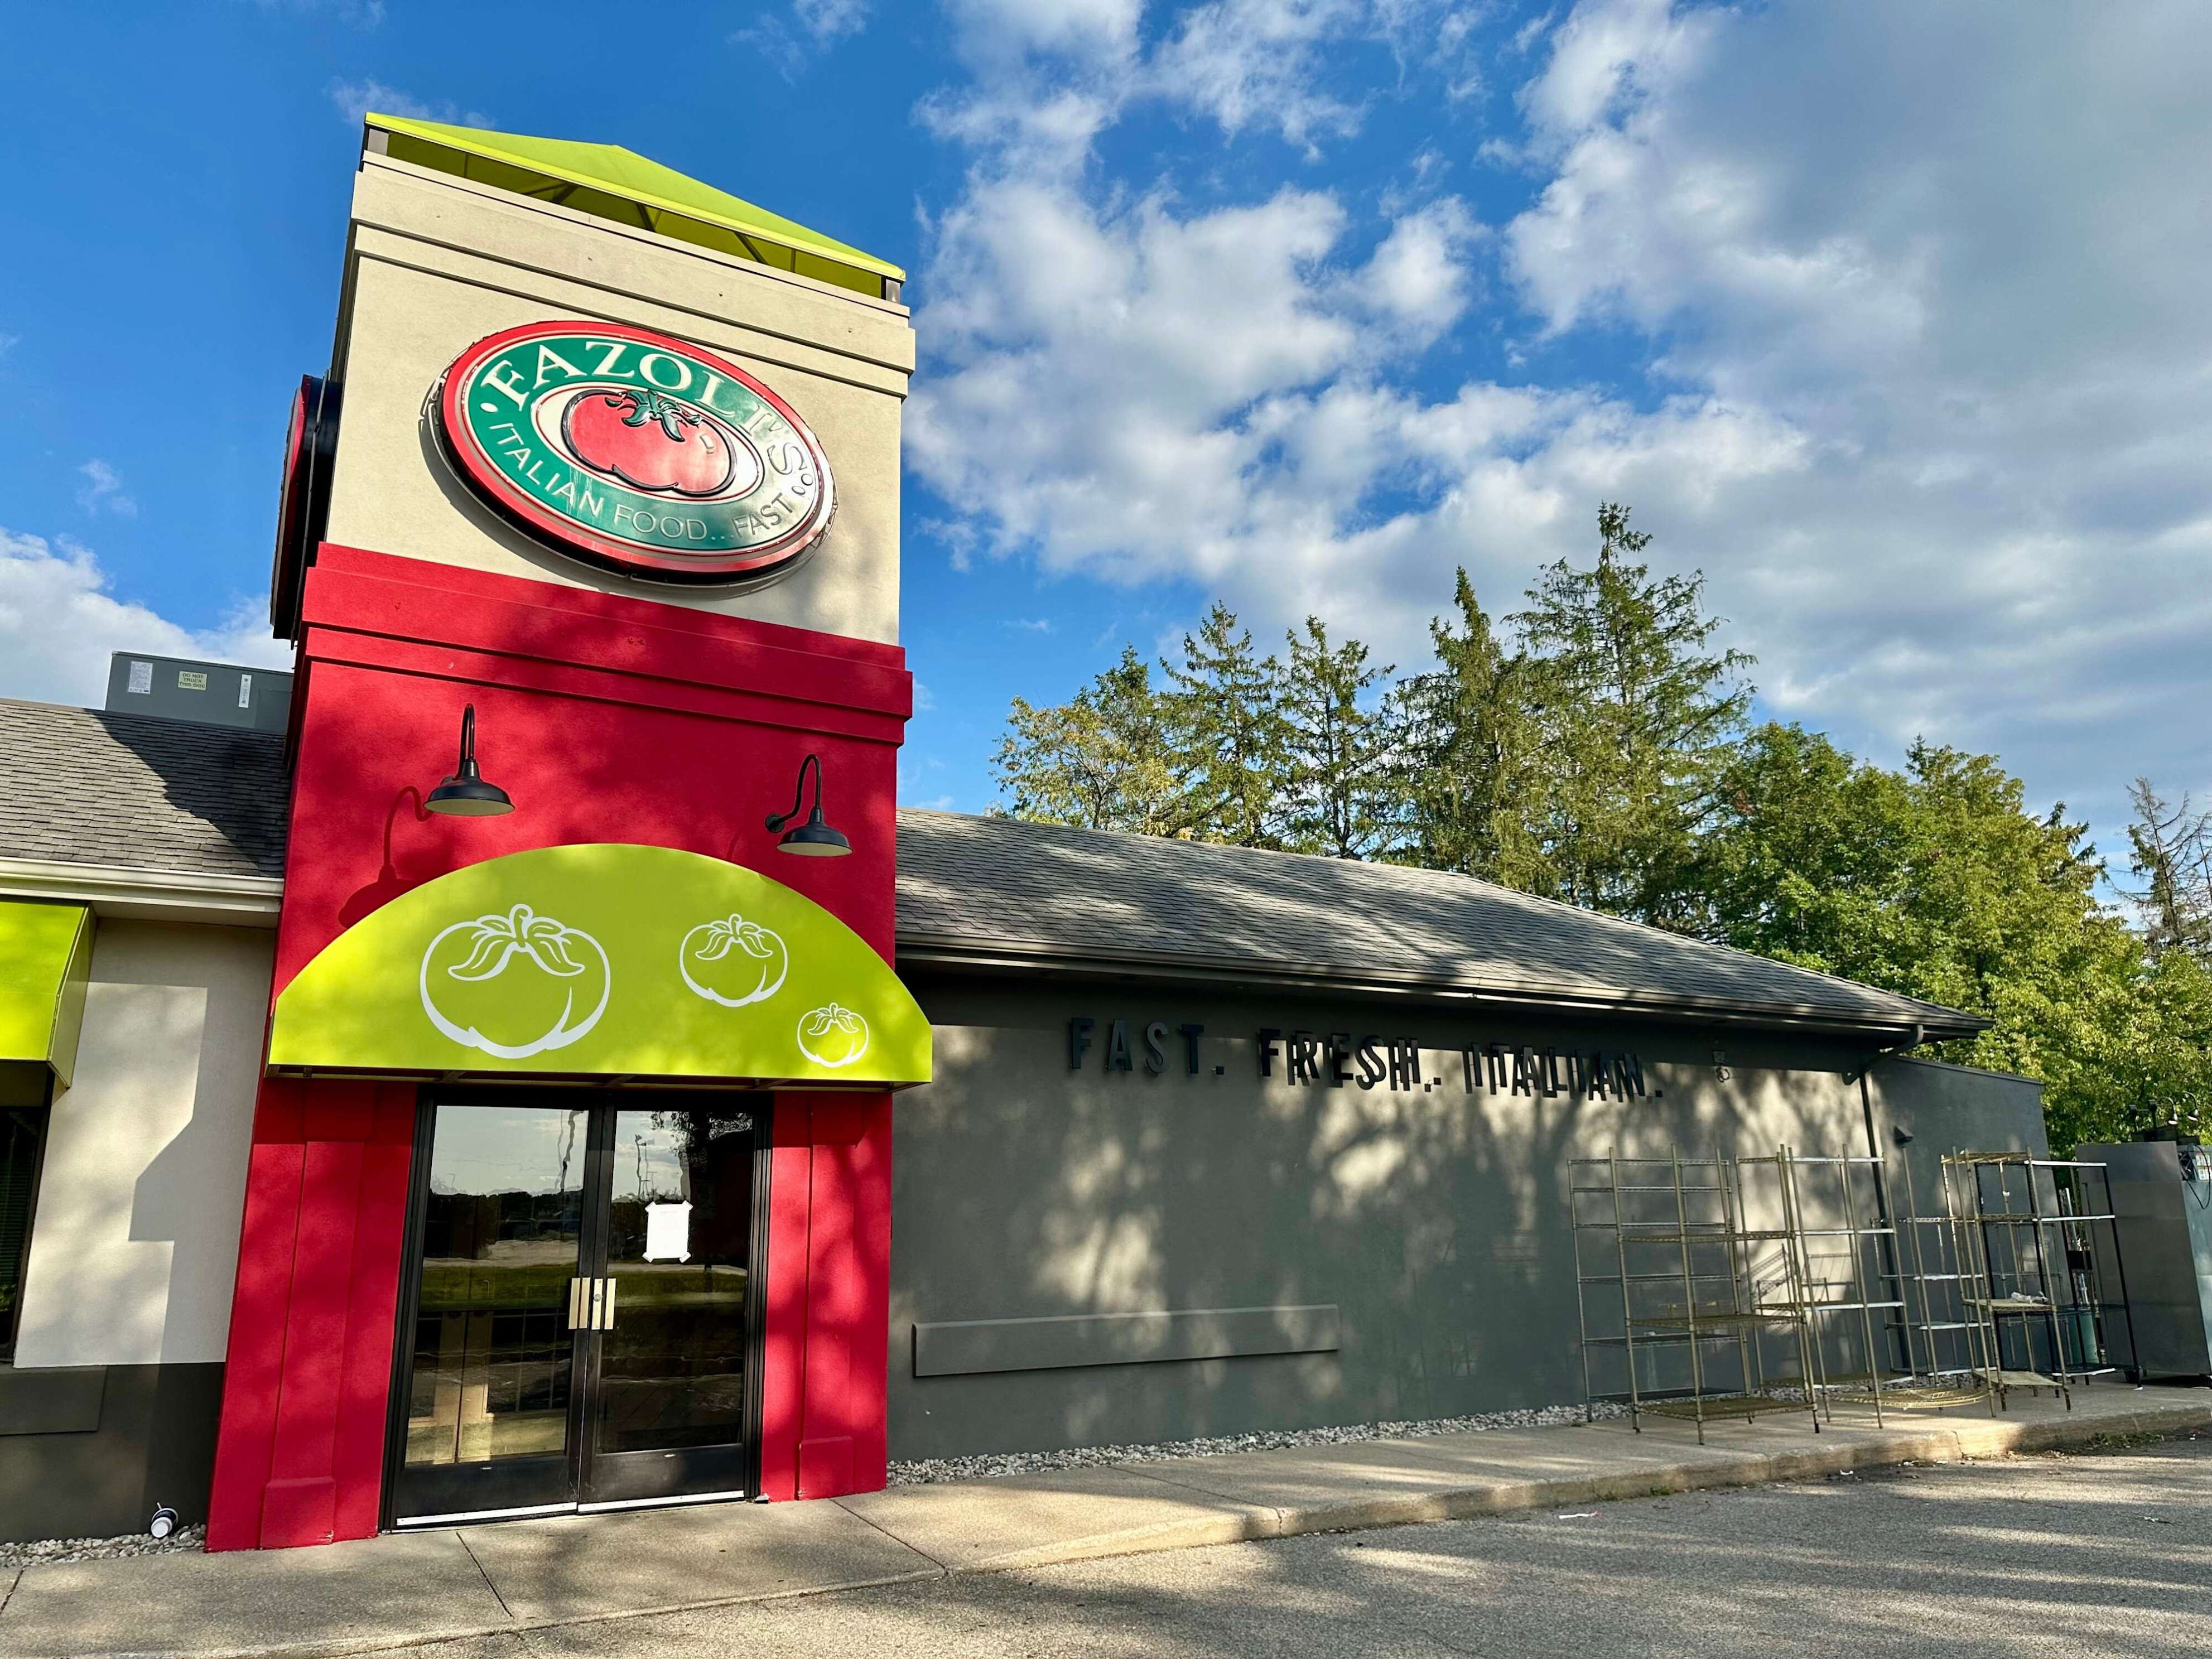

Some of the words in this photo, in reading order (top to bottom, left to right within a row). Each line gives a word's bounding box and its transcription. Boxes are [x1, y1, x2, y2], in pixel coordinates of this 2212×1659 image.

[480, 341, 808, 475] FAZOLI'S
[489, 423, 604, 518] ITALIAN
[1071, 1017, 1225, 1074] FAST.
[1259, 1028, 1442, 1086] FRESH.
[1470, 1041, 1663, 1098] ITALIAN.
